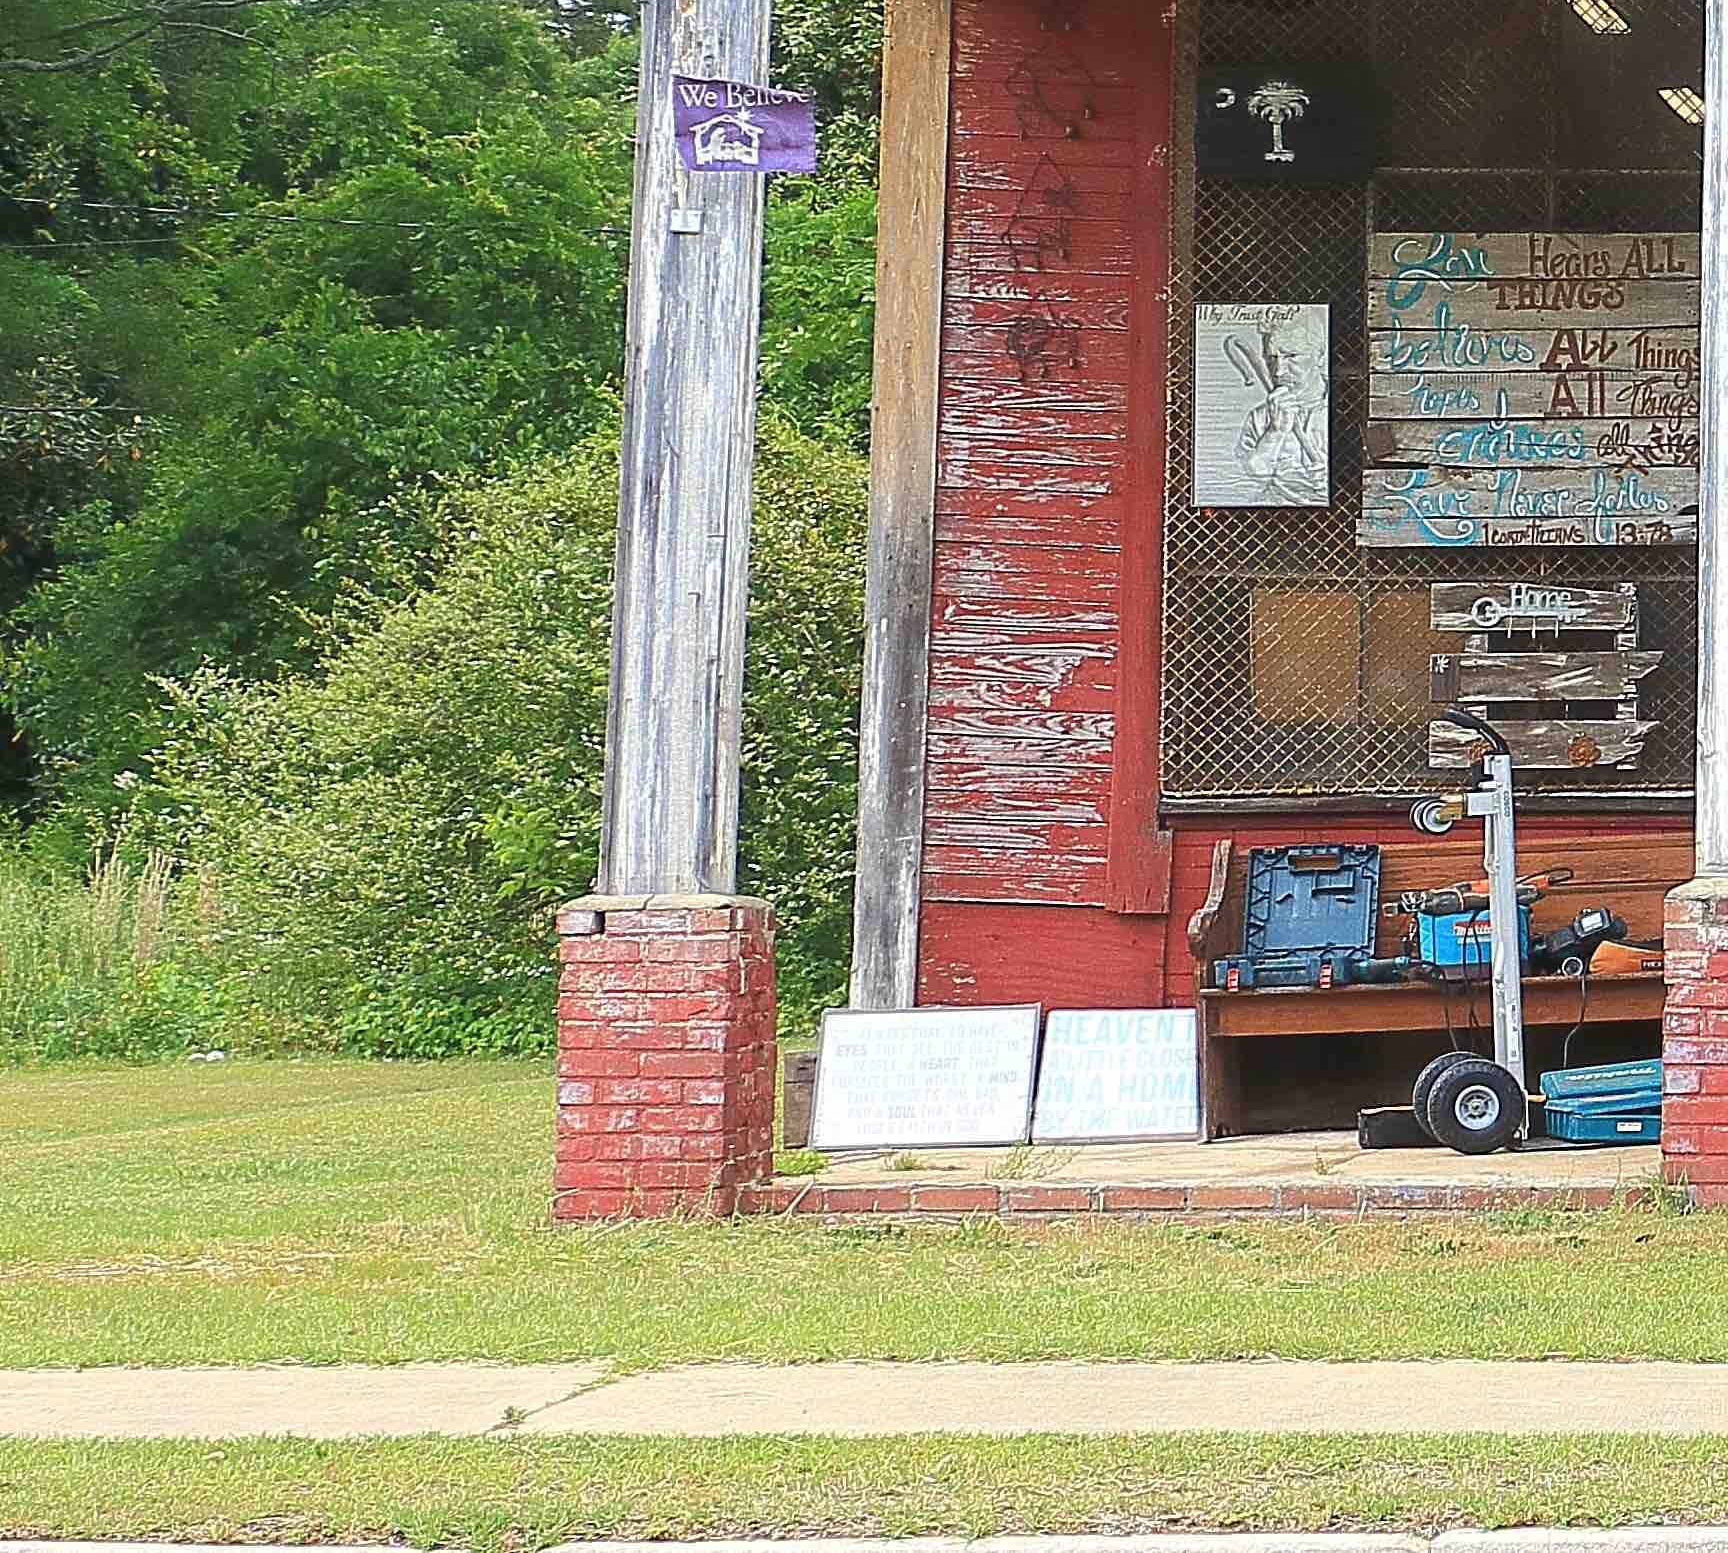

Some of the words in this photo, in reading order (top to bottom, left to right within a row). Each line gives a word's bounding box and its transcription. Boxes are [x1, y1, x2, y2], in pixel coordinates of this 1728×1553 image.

[678, 84, 718, 109] We
[726, 84, 811, 109] Believe
[1487, 280, 1625, 311] THINGS
[1198, 305, 1223, 326] Why
[1511, 584, 1572, 609] Home
[1051, 1014, 1174, 1045] HEAVEN
[918, 1057, 959, 1071] HEART
